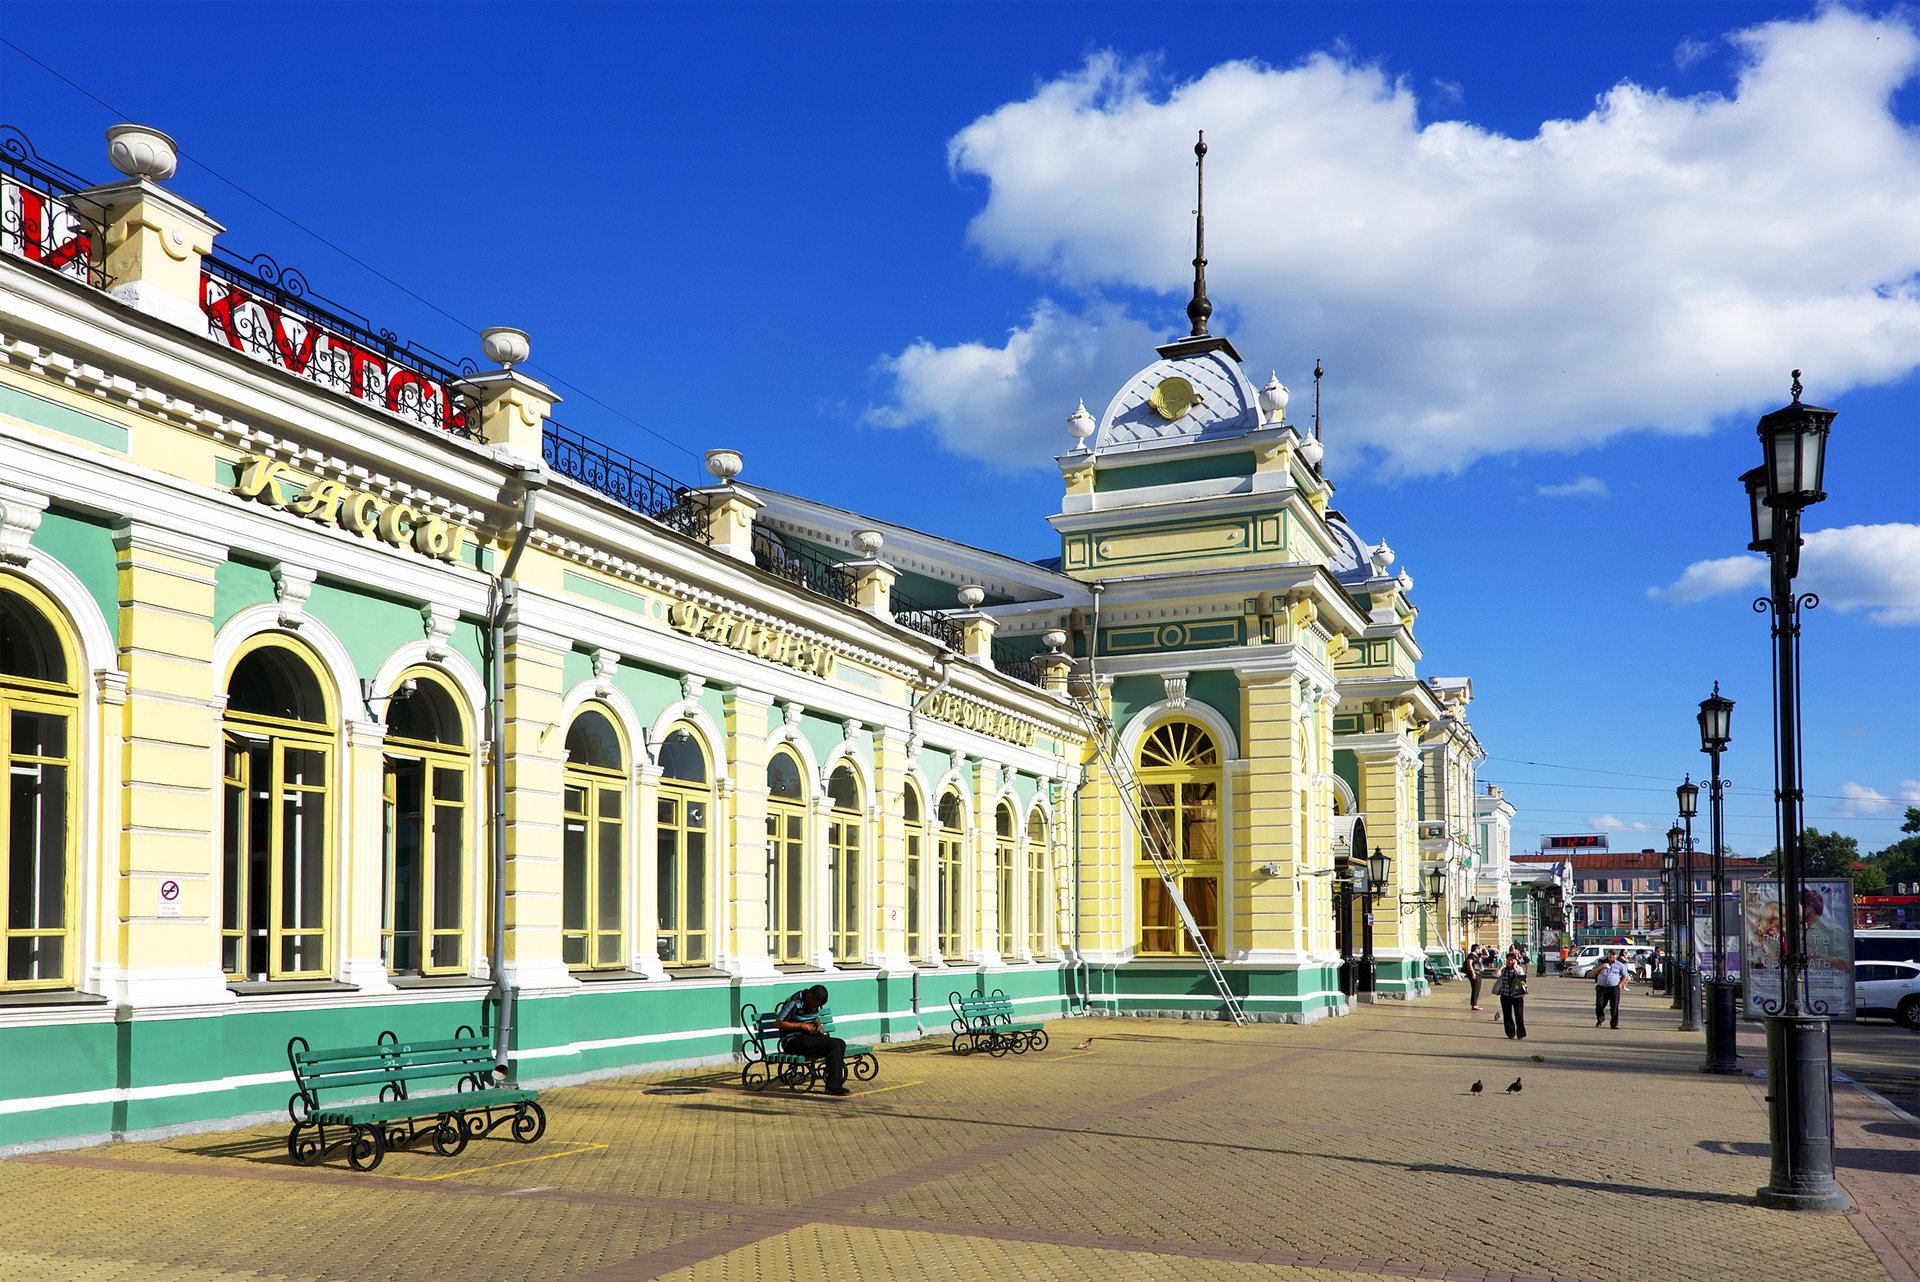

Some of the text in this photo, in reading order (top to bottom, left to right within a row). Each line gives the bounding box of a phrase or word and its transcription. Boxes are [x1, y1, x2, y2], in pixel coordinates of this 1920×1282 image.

[233, 455, 466, 562] КАССЫ
[672, 600, 837, 679] ДАЛЬНЕГО
[925, 693, 1039, 747] СЛЕДОВАНИЯ
